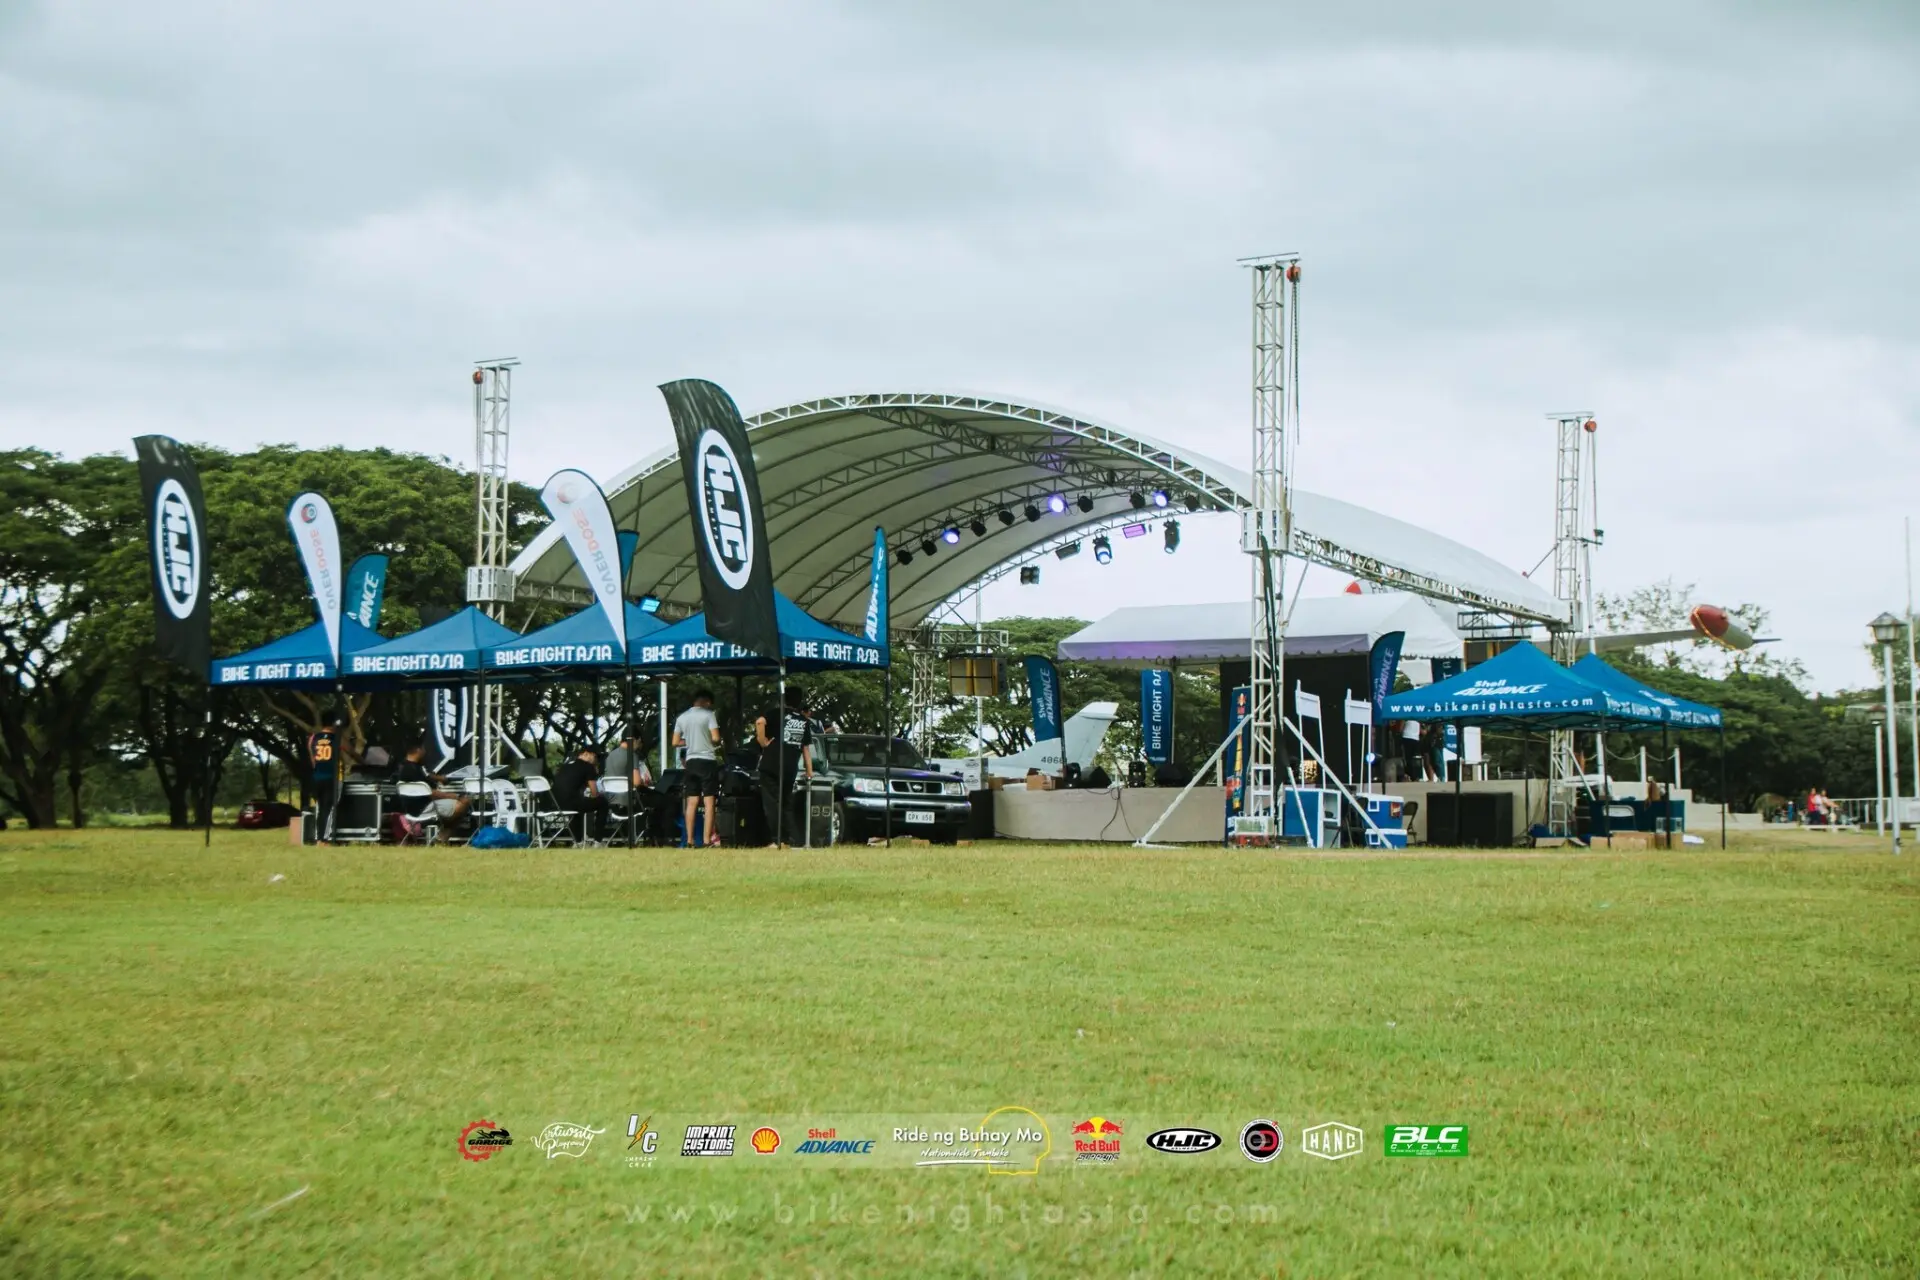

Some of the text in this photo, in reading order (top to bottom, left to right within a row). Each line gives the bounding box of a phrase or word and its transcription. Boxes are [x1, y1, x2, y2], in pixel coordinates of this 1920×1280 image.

[704, 453, 748, 562] HJC
[164, 500, 193, 596] HJC
[642, 644, 675, 663] BIKE
[681, 641, 724, 660] NIGHT
[793, 640, 880, 665] BIKE NIGHT ASIA
[221, 661, 326, 682] BIKE NIGHT ASIA
[1452, 683, 1548, 697] ADVANCE
[1474, 679, 1507, 688] Shell
[1041, 667, 1054, 726] ADVANCE
[1152, 690, 1162, 722] NIGHT
[1390, 697, 1594, 714] www.bikenightasia.com
[1151, 725, 1161, 750] BIKE
[314, 745, 332, 761] 30
